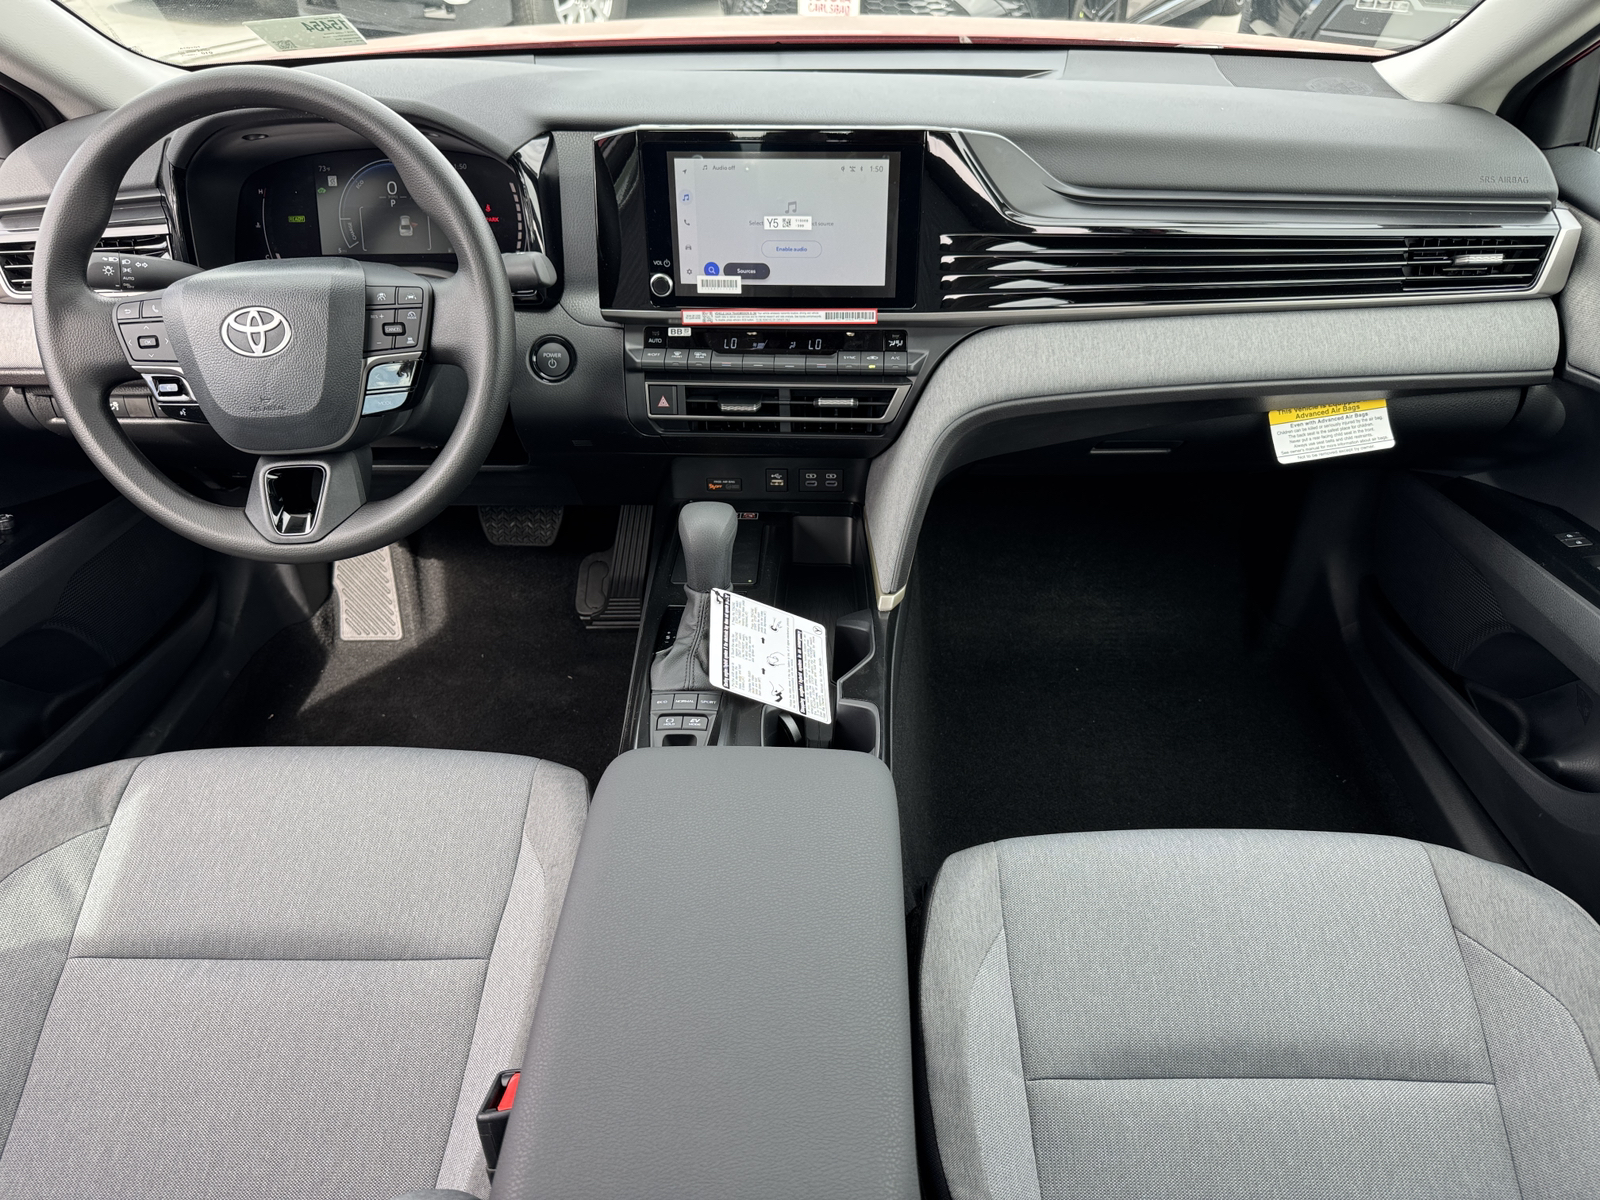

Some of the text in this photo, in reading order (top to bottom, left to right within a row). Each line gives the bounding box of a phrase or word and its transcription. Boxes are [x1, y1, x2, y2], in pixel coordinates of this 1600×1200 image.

[1480, 176, 1495, 184] SRS
[766, 218, 778, 228] Y5
[724, 338, 737, 349] LO
[808, 339, 822, 350] LO
[1296, 408, 1330, 419] Advanced
[1342, 404, 1360, 412] Bags
[1318, 416, 1344, 424] Advanced
